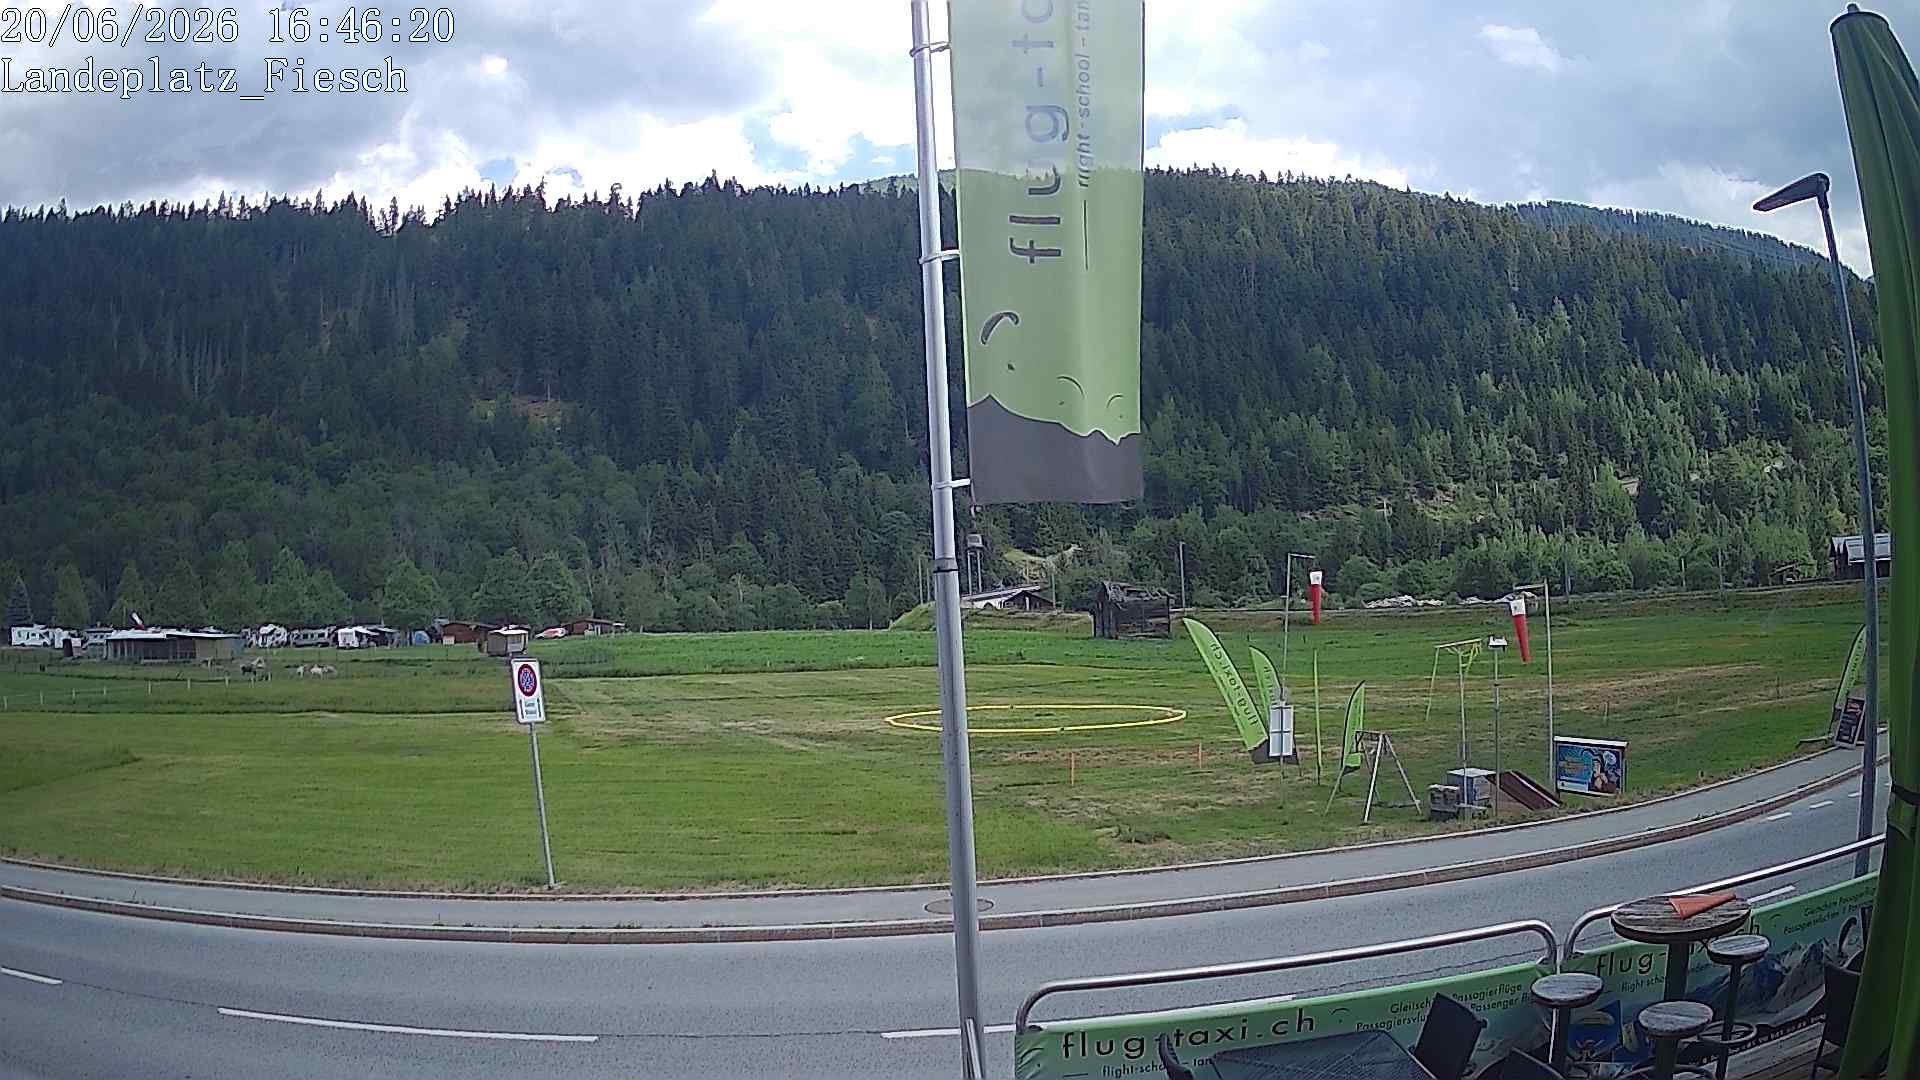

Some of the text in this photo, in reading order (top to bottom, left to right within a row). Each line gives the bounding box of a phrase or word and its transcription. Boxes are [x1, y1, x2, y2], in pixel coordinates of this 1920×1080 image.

[1390, 996, 1431, 1014] Gleitsch
[1356, 1011, 1426, 1031] Passagiersvlu
[1102, 1061, 1167, 1079] flight-scho
